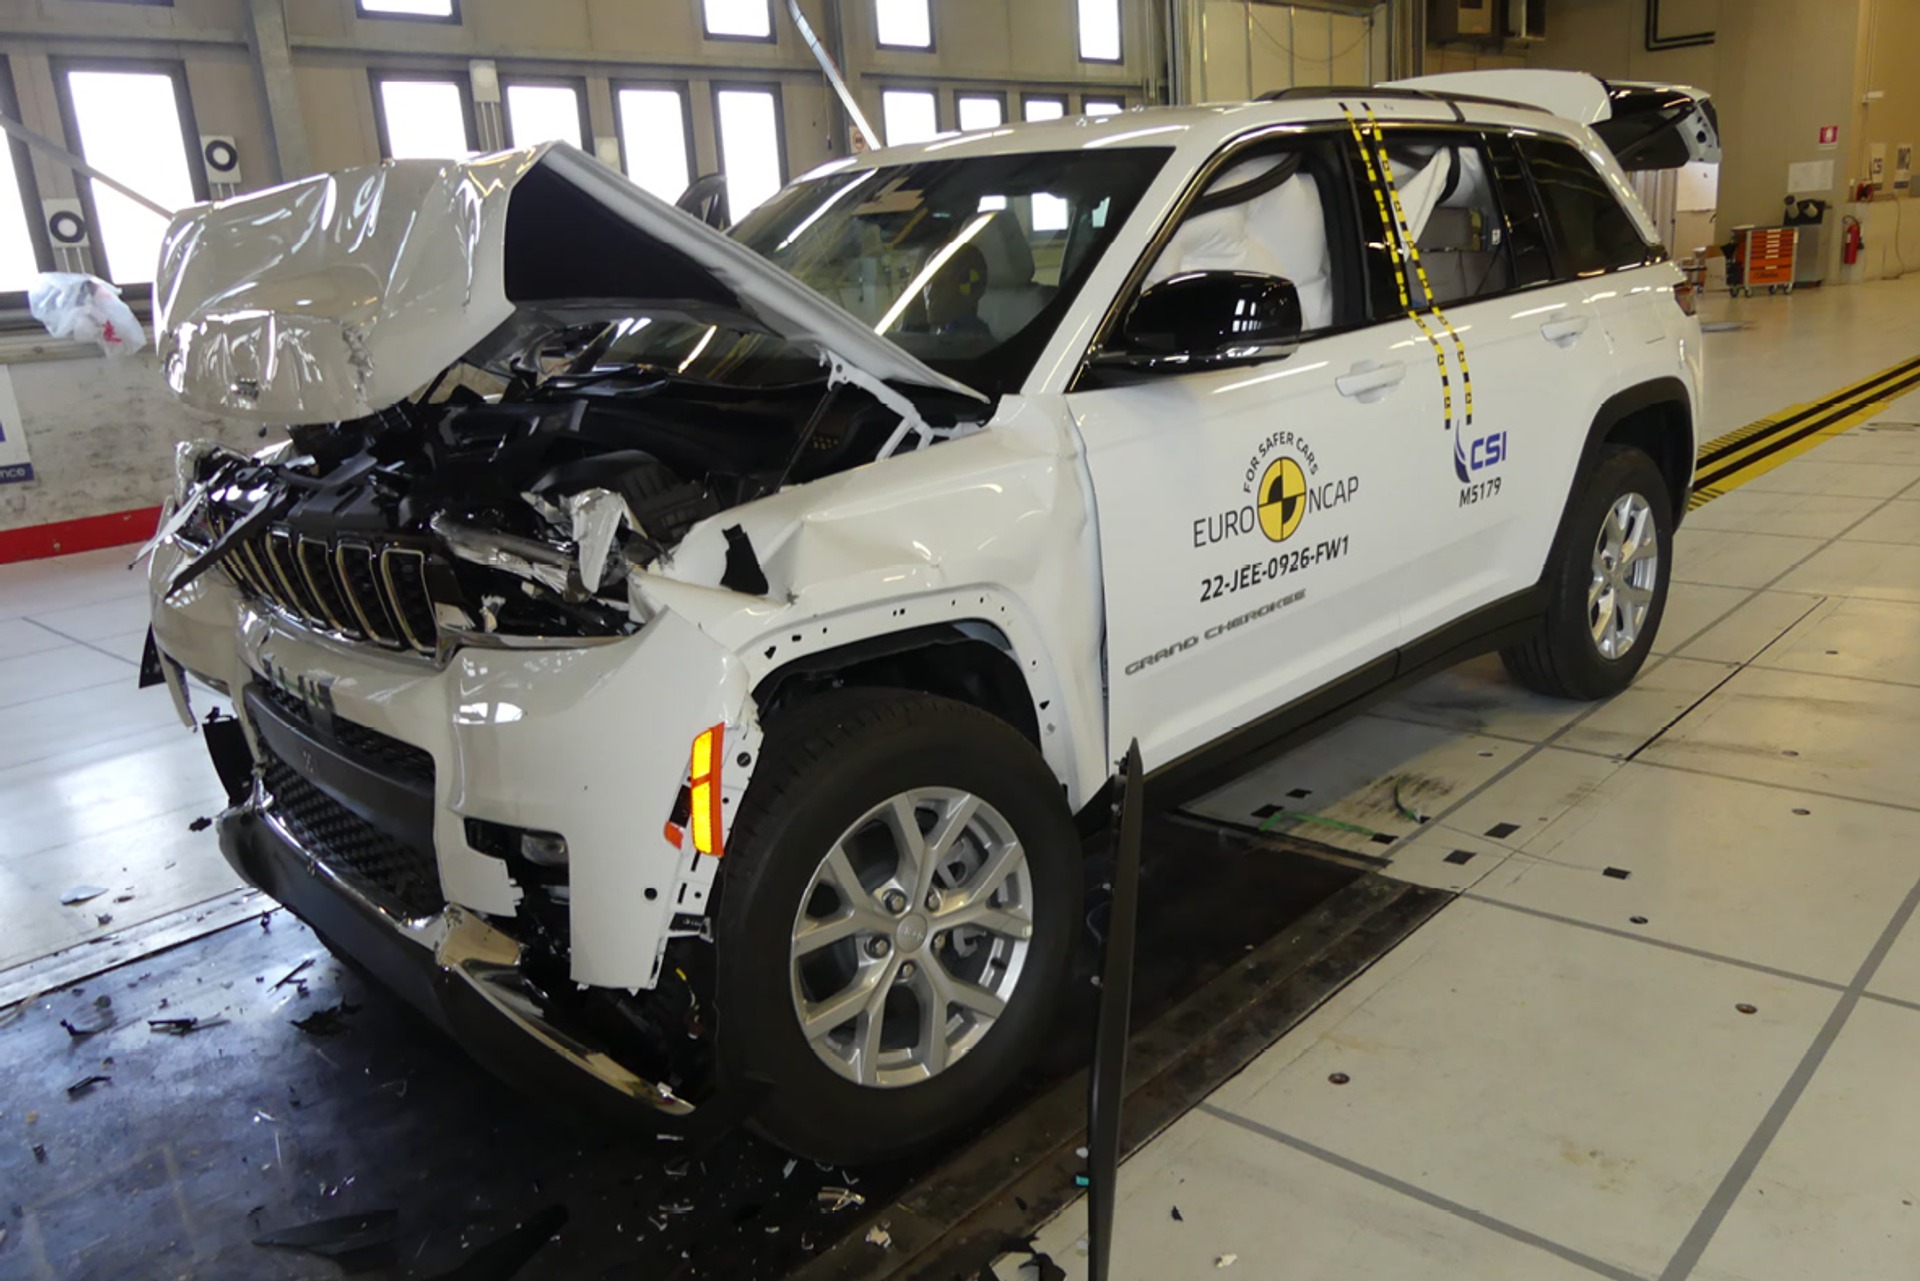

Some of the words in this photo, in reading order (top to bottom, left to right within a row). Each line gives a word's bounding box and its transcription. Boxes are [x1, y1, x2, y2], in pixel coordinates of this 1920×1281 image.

[1243, 456, 1260, 494] FOR
[1258, 431, 1294, 458] SAFER
[1296, 437, 1319, 476] CARS
[1470, 430, 1507, 471] CSI
[1193, 505, 1255, 548] EURO
[1308, 476, 1359, 514] NCAP
[1459, 476, 1502, 508] M5179
[1200, 534, 1349, 603] 22-JEE-0926-FW1
[1125, 635, 1199, 675] GRAND
[1204, 588, 1307, 640] CHEROKEE
